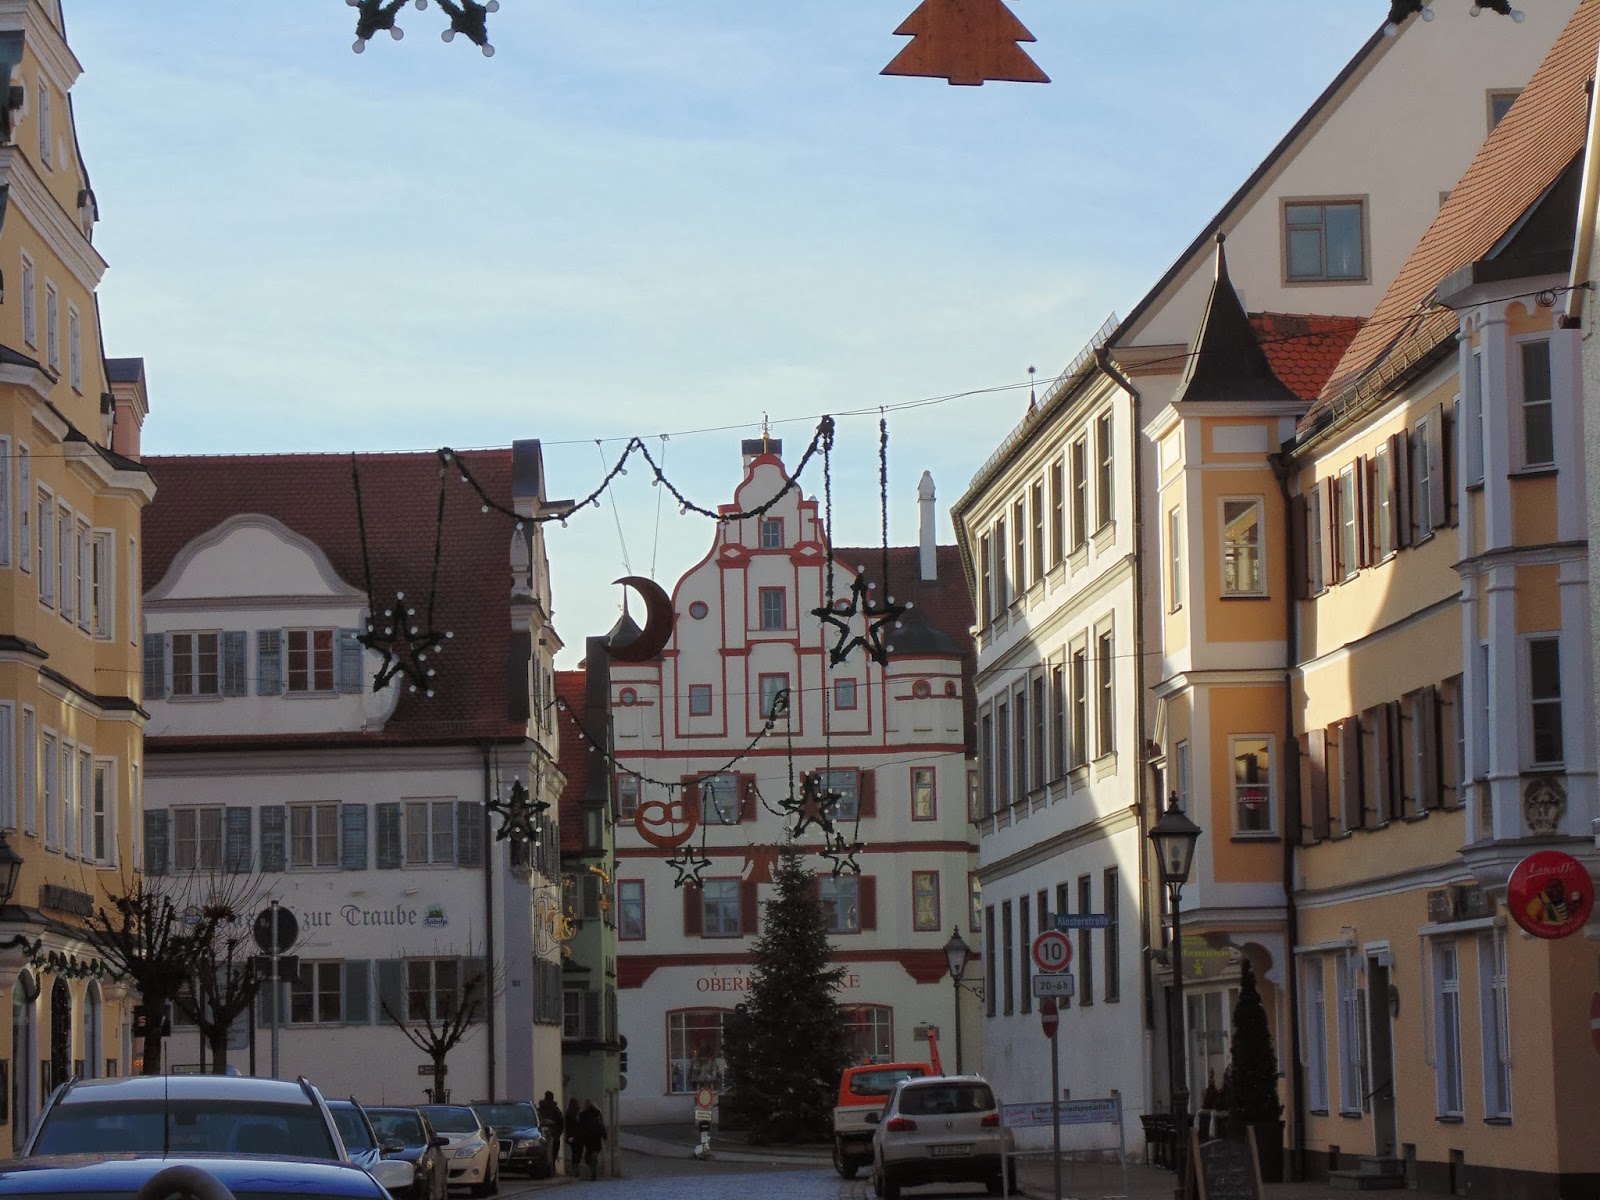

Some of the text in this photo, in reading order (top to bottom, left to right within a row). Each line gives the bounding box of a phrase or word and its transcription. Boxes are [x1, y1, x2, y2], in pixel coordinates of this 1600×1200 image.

[302, 911, 332, 932] zur
[340, 904, 418, 926] Traube
[1057, 916, 1109, 926] Klosterstraße
[1042, 943, 1062, 960] 10
[1036, 1104, 1110, 1114] Der Fhrradspezialist
